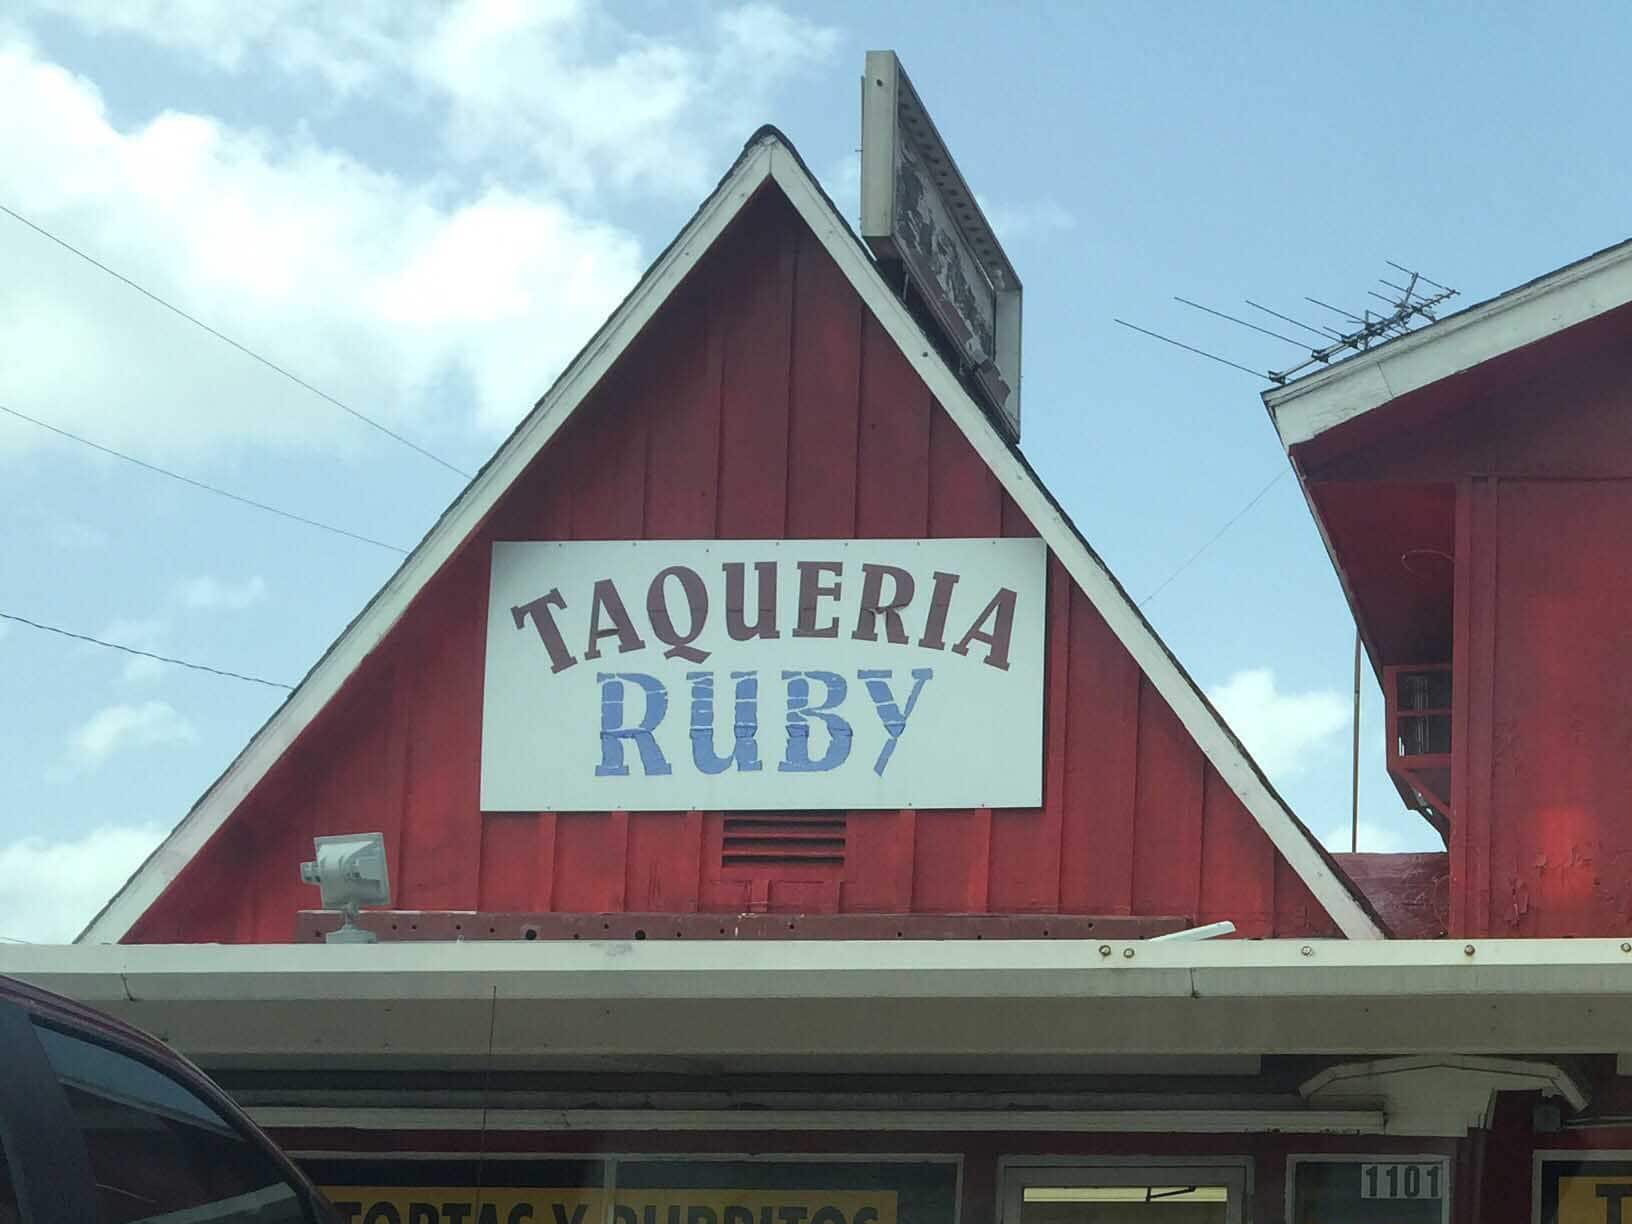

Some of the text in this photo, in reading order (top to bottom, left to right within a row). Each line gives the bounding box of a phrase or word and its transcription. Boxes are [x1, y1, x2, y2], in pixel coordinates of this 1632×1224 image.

[510, 561, 1018, 674] TAQUERIA
[595, 668, 934, 777] RUBY
[1365, 1165, 1442, 1198] 1101
